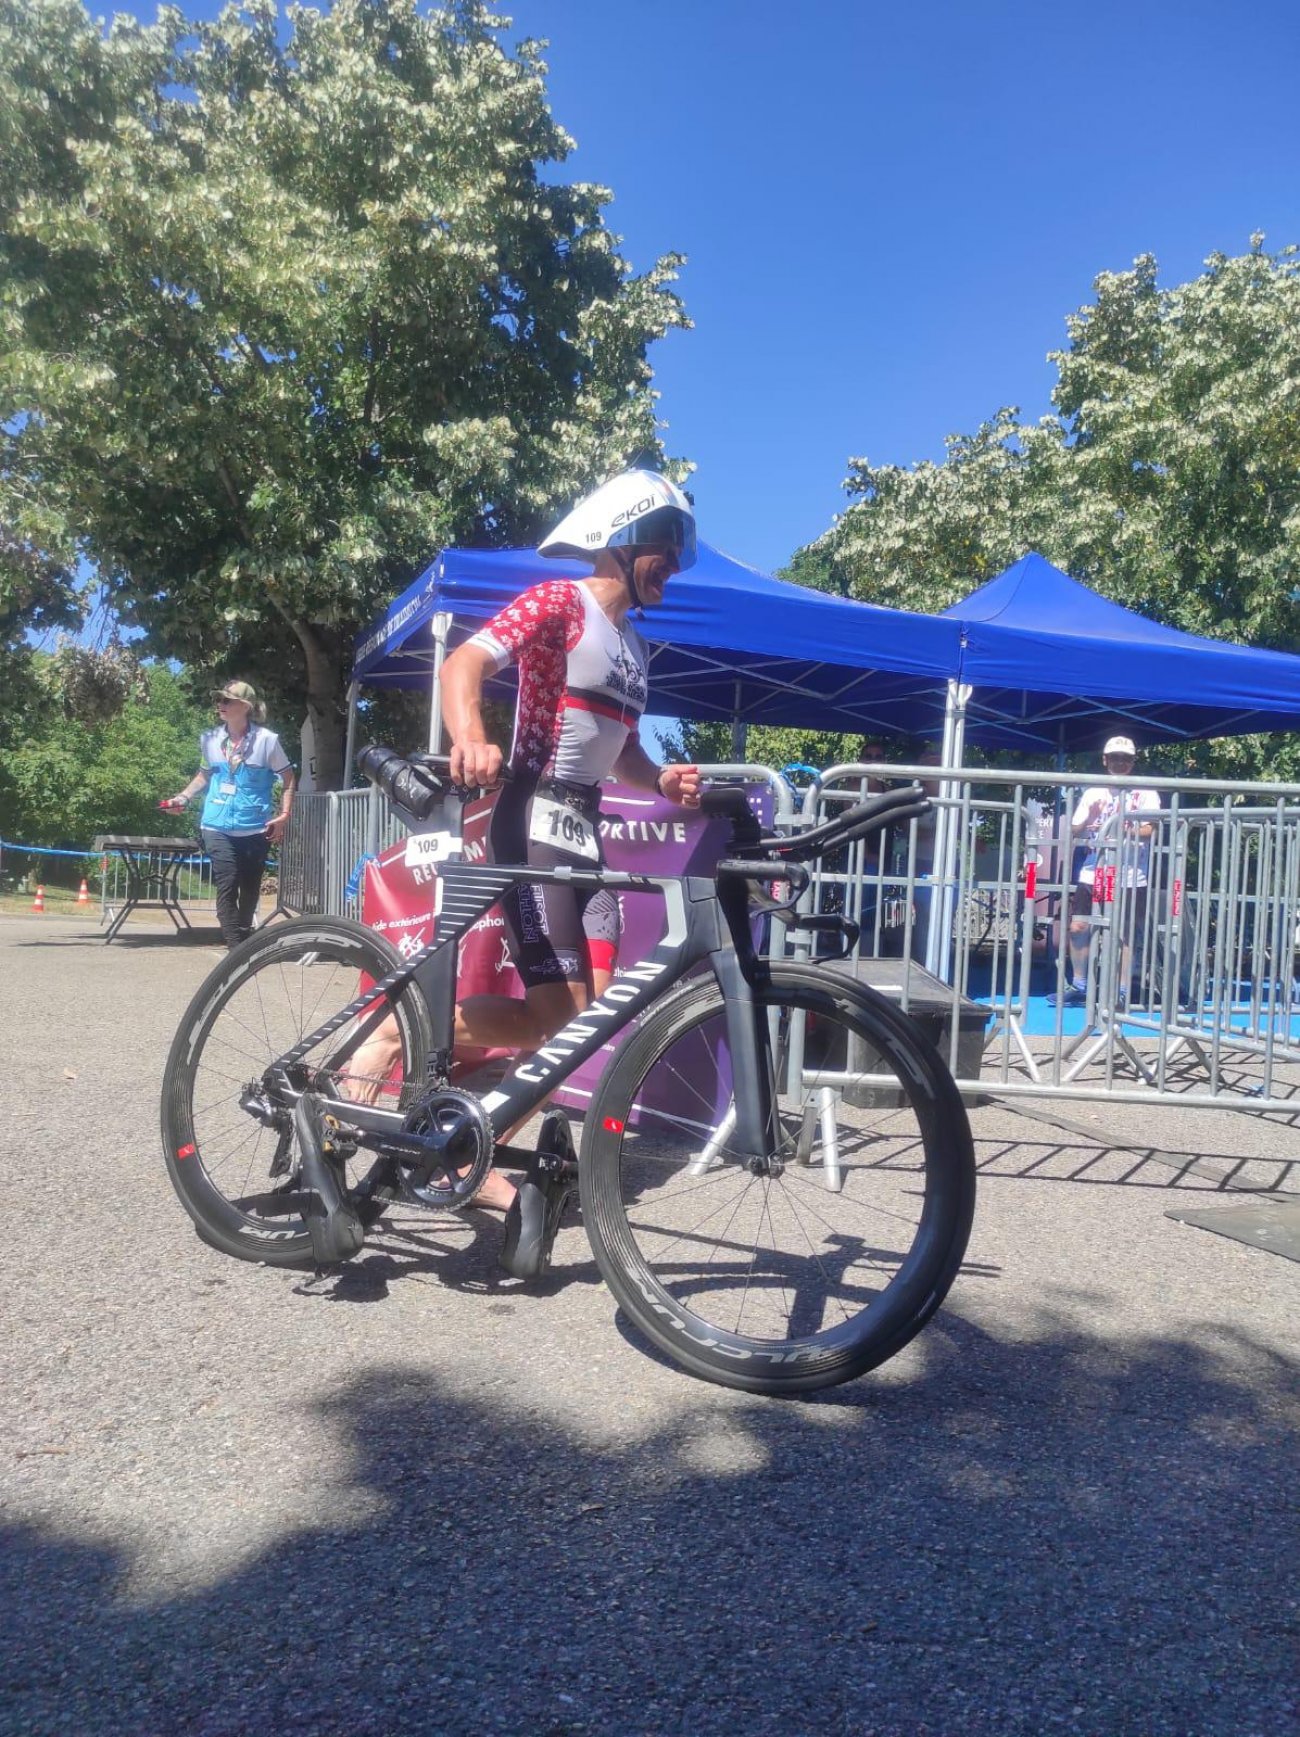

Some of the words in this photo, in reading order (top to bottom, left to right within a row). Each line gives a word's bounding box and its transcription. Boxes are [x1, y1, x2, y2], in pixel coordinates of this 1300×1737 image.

[585, 530, 603, 544] 109
[548, 809, 587, 847] 109
[416, 838, 439, 854] 109
[514, 960, 669, 1083] CANYON
